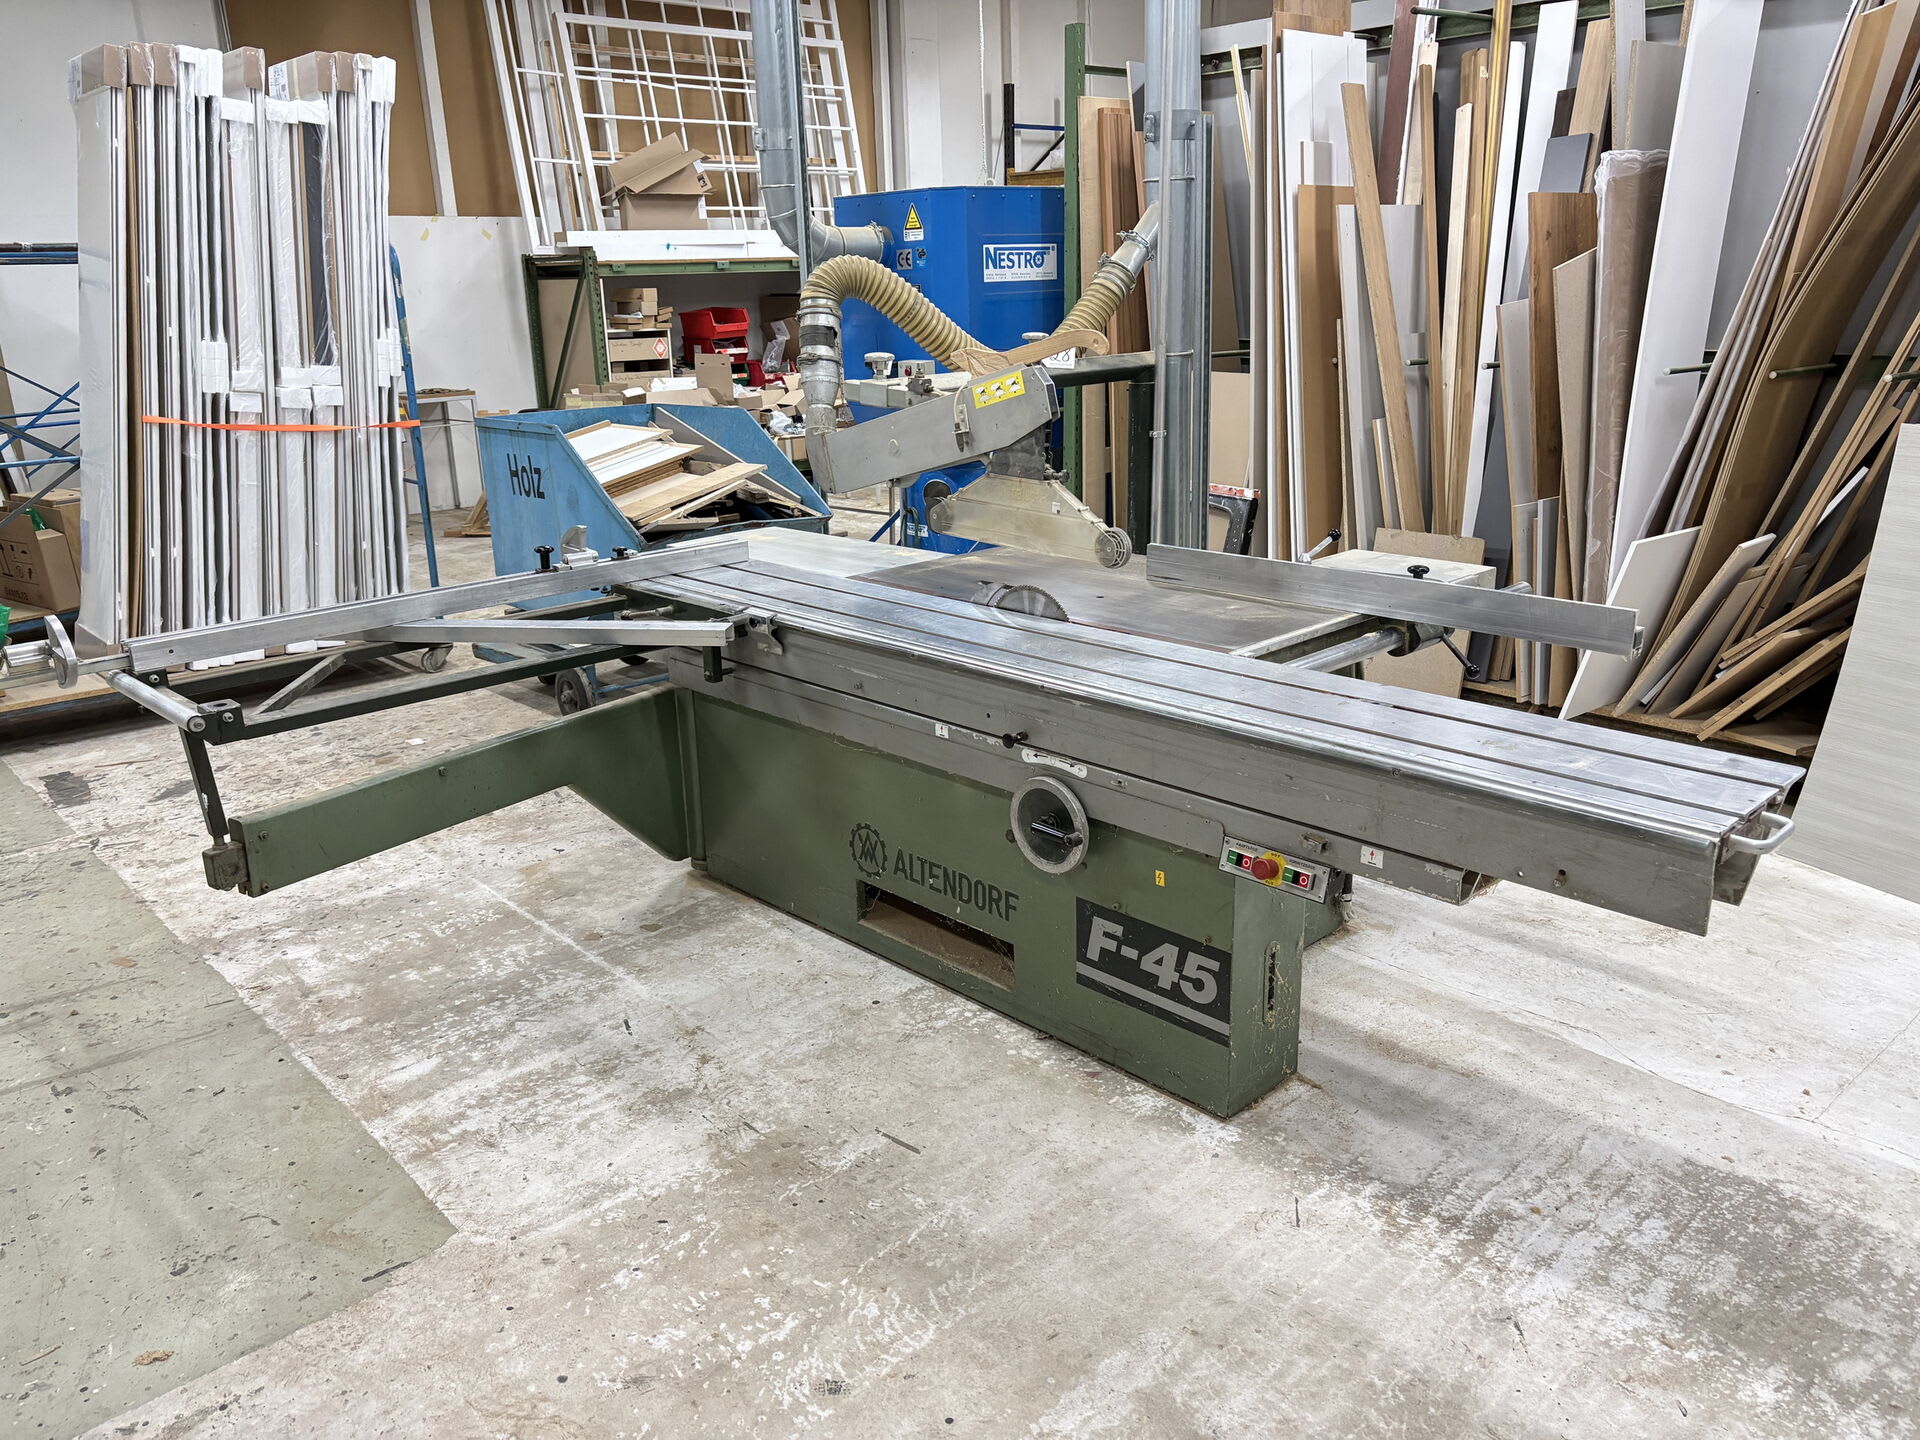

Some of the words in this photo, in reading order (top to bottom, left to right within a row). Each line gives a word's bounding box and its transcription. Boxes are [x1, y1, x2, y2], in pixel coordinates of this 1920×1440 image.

[898, 251, 911, 267] CE
[985, 247, 1050, 269] NESTRO
[507, 453, 545, 500] Holz
[893, 849, 1019, 921] ALTENDORF
[1087, 916, 1220, 1004] F-45
